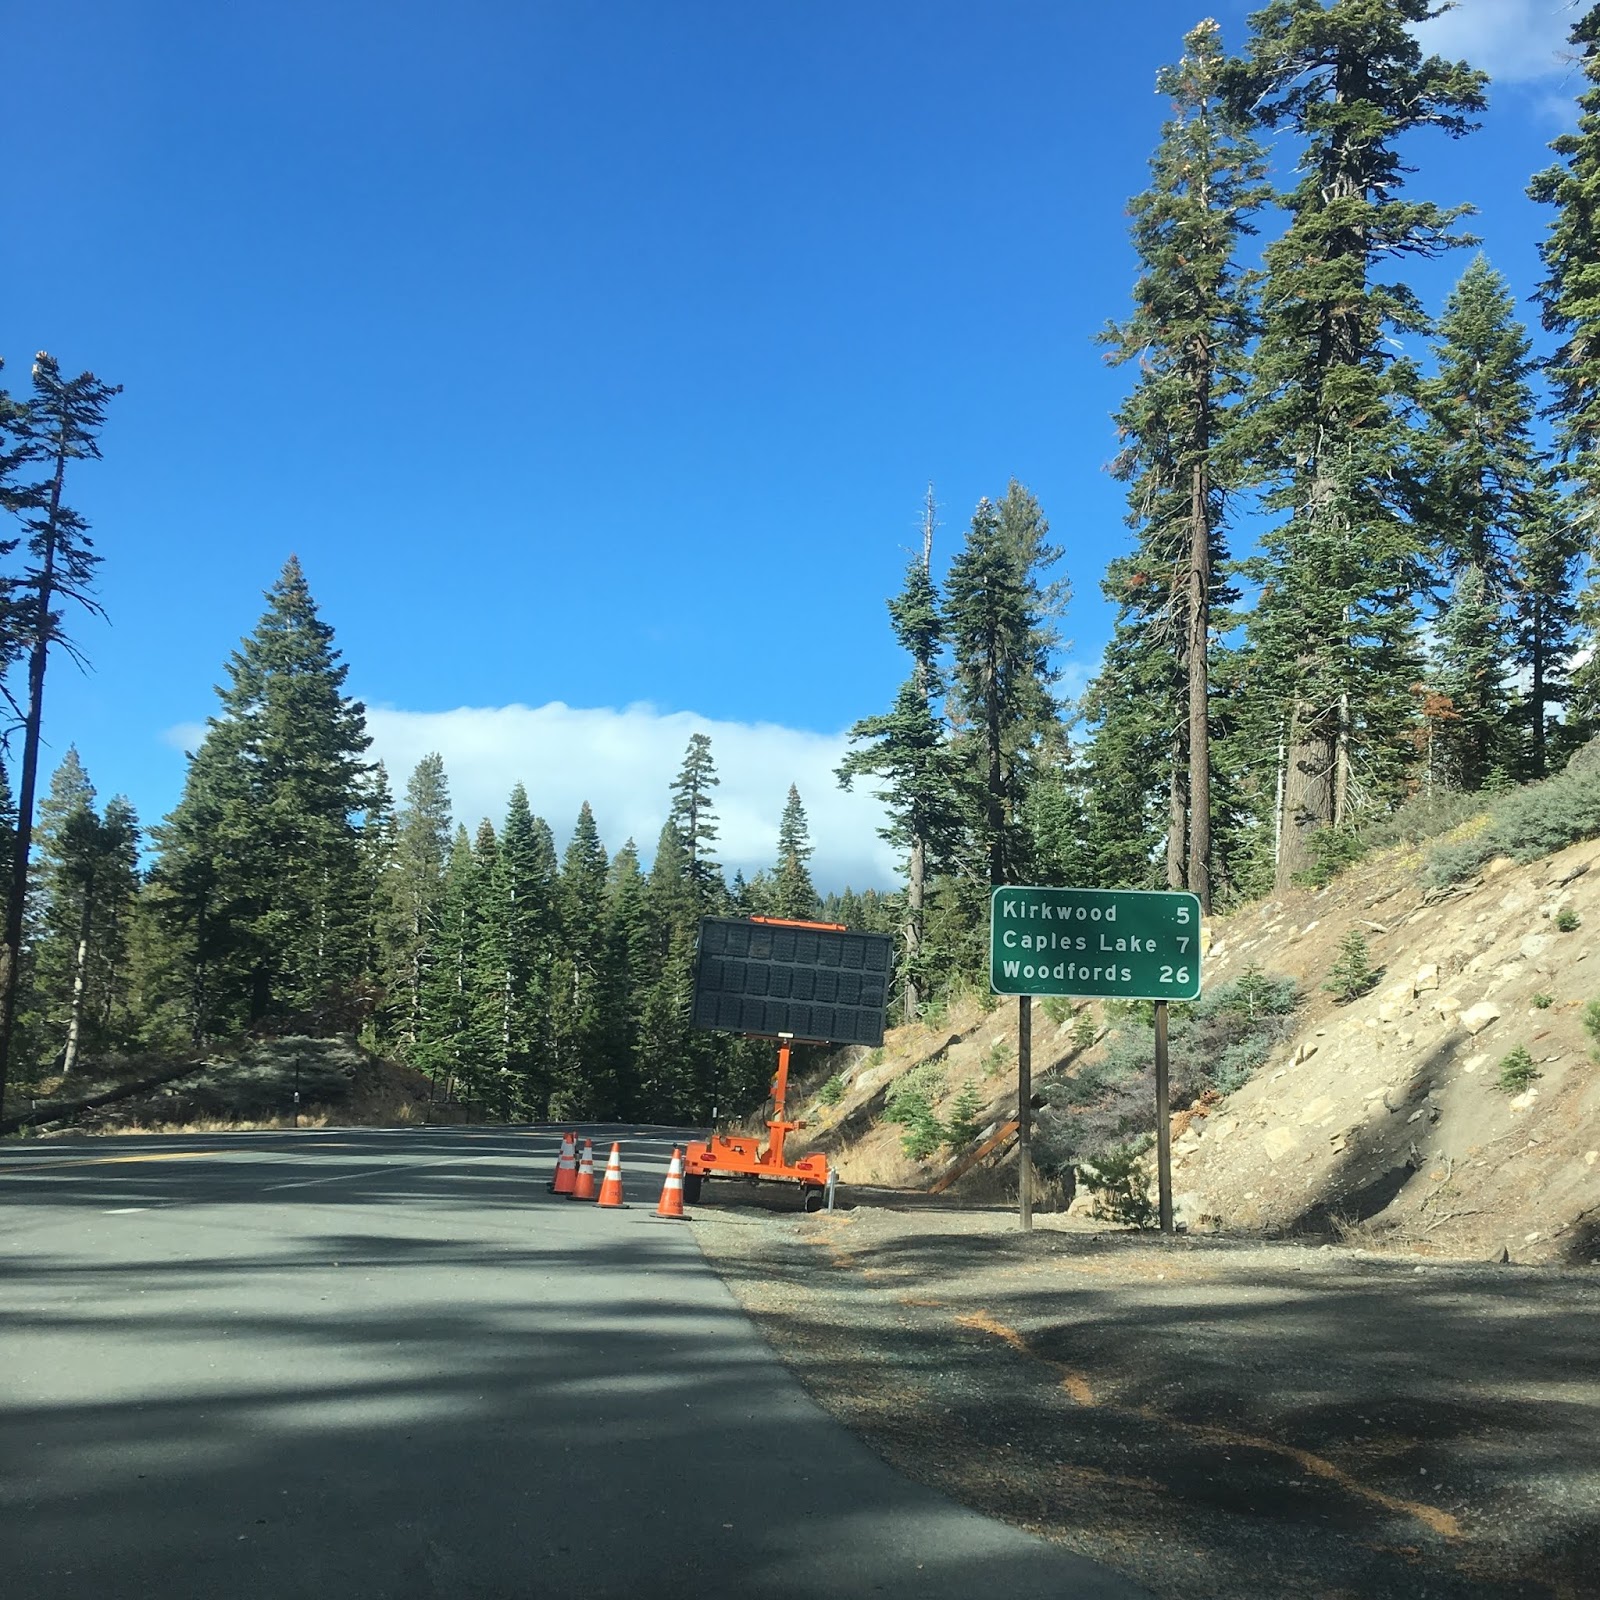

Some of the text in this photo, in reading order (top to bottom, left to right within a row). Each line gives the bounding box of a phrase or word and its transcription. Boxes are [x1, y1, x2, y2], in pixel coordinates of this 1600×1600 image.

[1003, 901, 1190, 925] Kirkwood 5
[1003, 930, 1190, 954] Caples Lake 7
[1003, 960, 1190, 984] Woodfords 26
